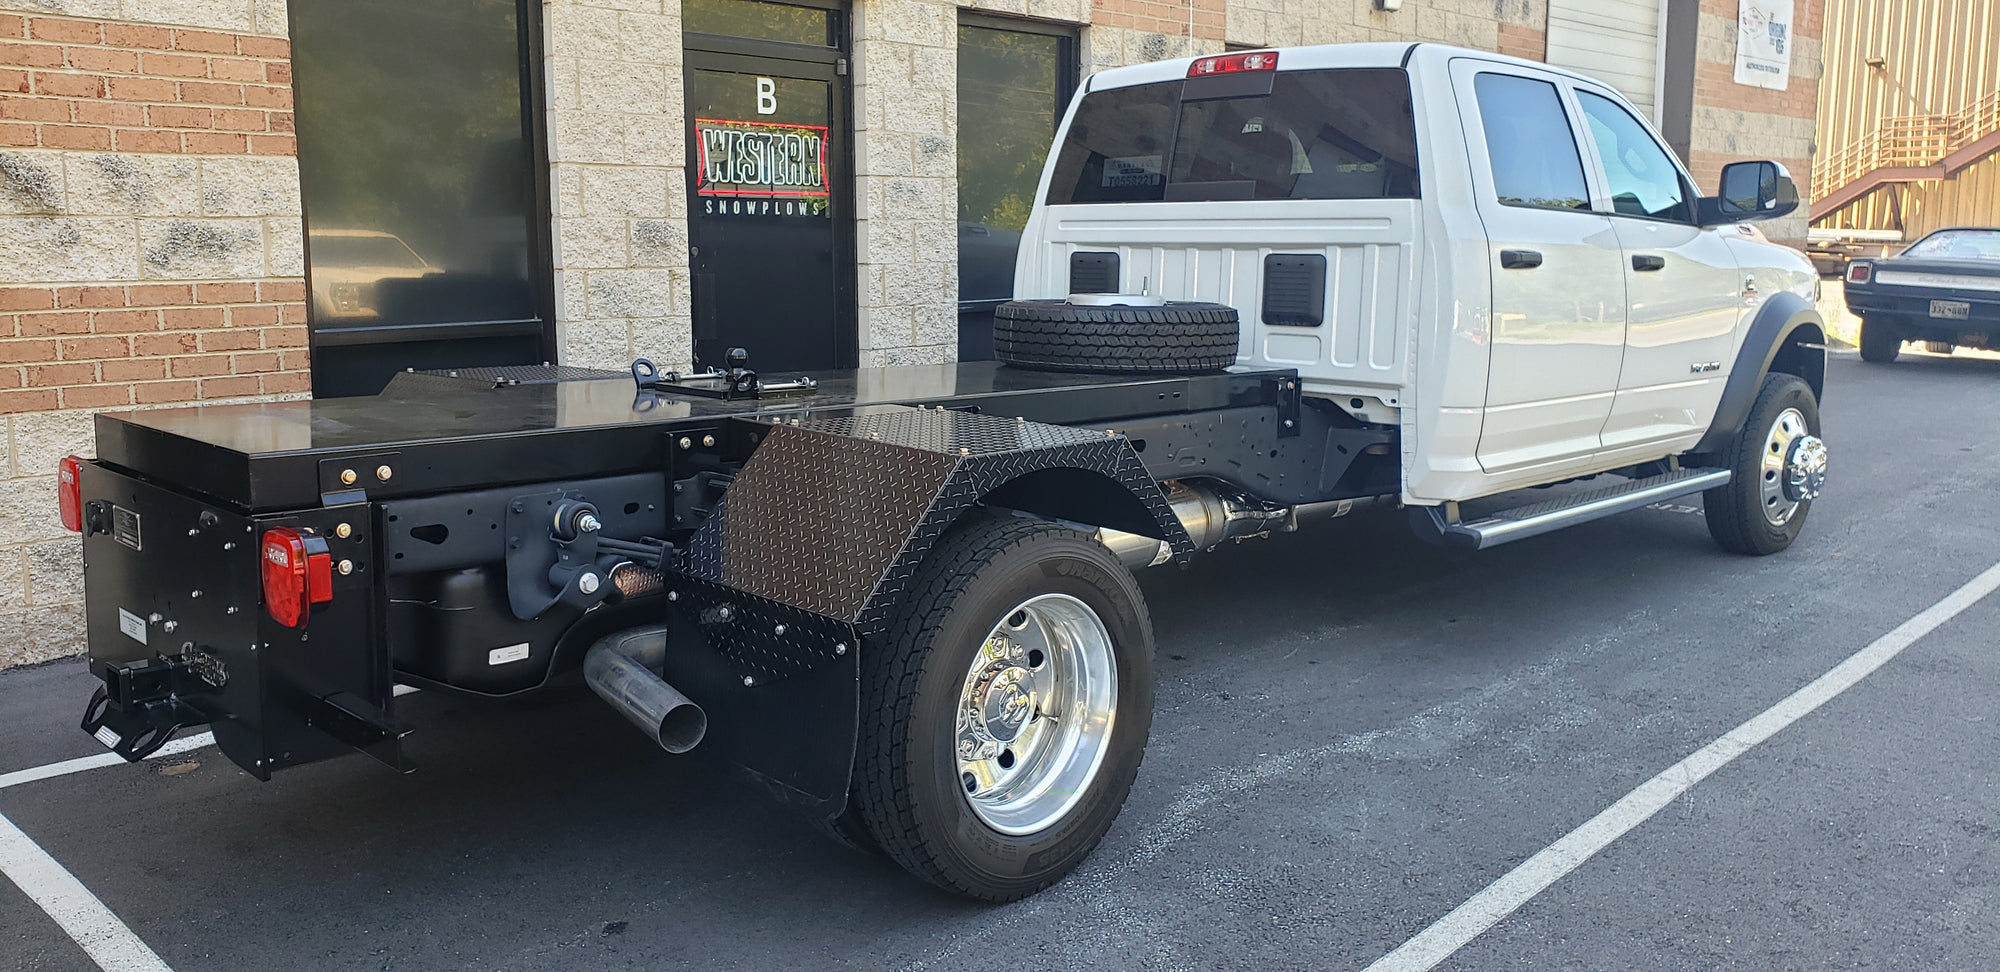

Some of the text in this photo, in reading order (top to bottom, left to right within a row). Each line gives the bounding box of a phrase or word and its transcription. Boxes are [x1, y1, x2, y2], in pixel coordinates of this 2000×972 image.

[756, 77, 777, 115] B
[702, 128, 821, 187] WESTERN
[705, 200, 820, 216] SNOWPLOWS
